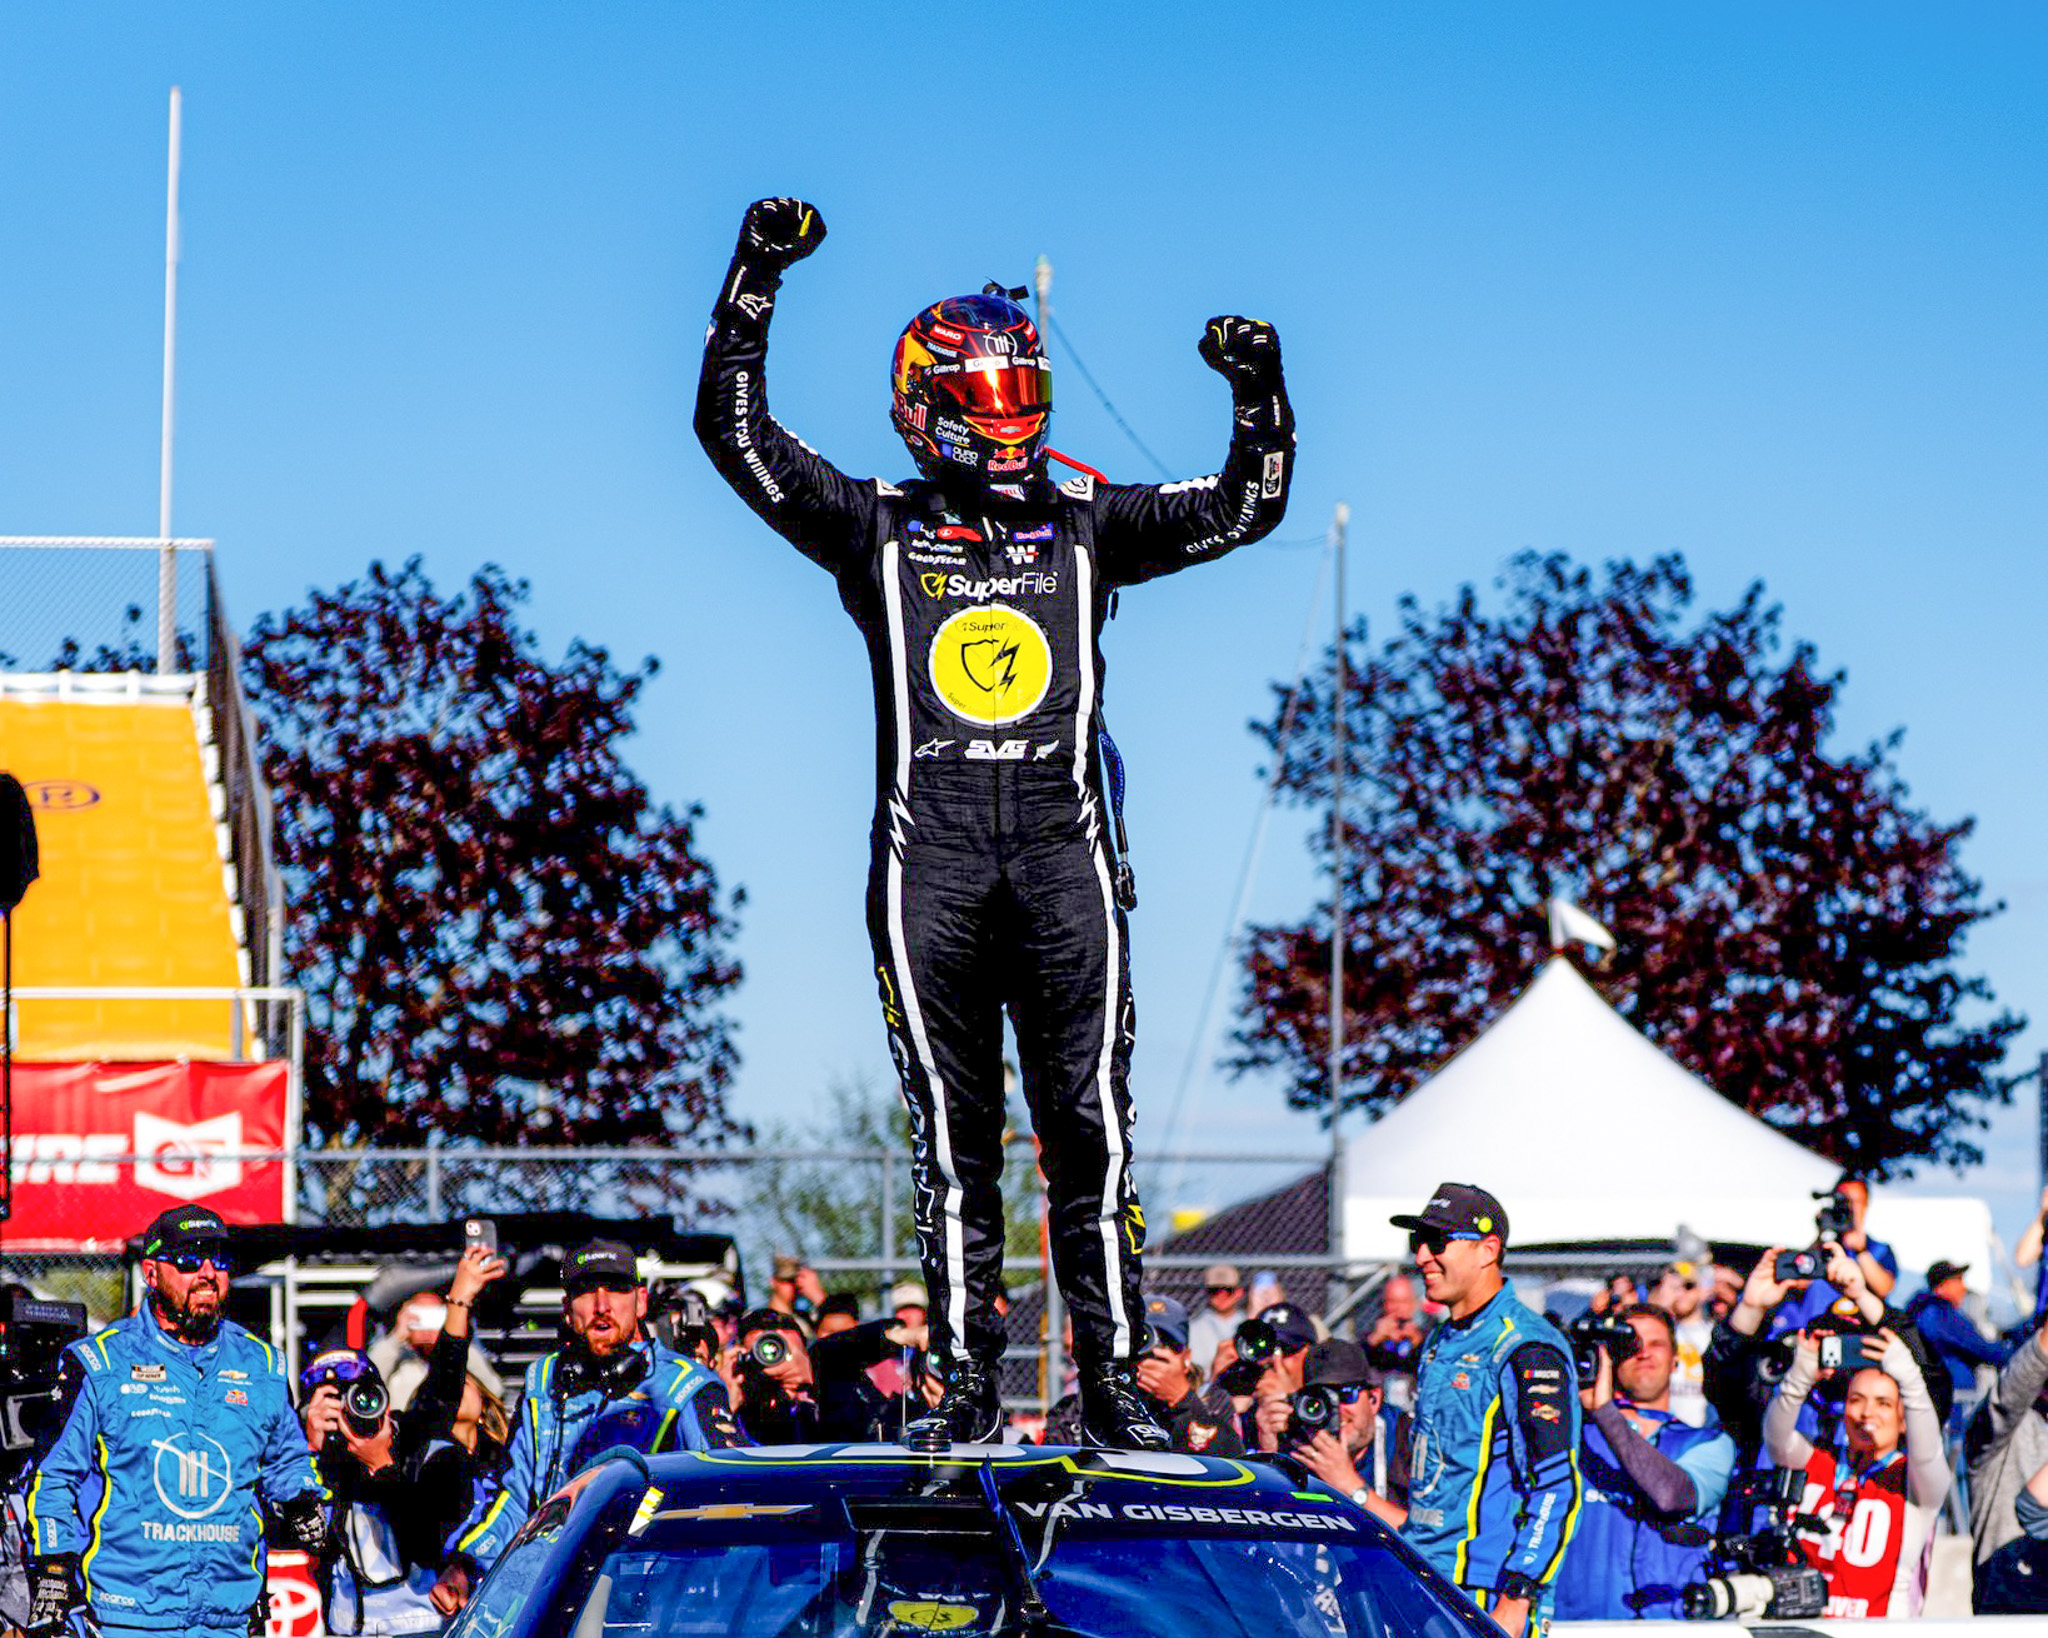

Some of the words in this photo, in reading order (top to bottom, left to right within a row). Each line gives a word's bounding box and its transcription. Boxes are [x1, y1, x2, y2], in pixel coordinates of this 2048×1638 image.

[734, 370, 749, 416] GIVES
[734, 417, 752, 449] YOU
[935, 427, 971, 445] Culture
[937, 416, 970, 435] Safety
[987, 458, 1004, 471] Red
[1009, 456, 1028, 470] Bull
[743, 447, 785, 503] WIIINGS
[907, 551, 967, 567] GOODYEAR
[945, 571, 1058, 604] SuperFile
[963, 739, 1030, 761] SVG
[1015, 1501, 1114, 1519] VAN
[1121, 1503, 1357, 1532] GISBERGEN
[141, 1521, 241, 1542] TRACKHOUSE
